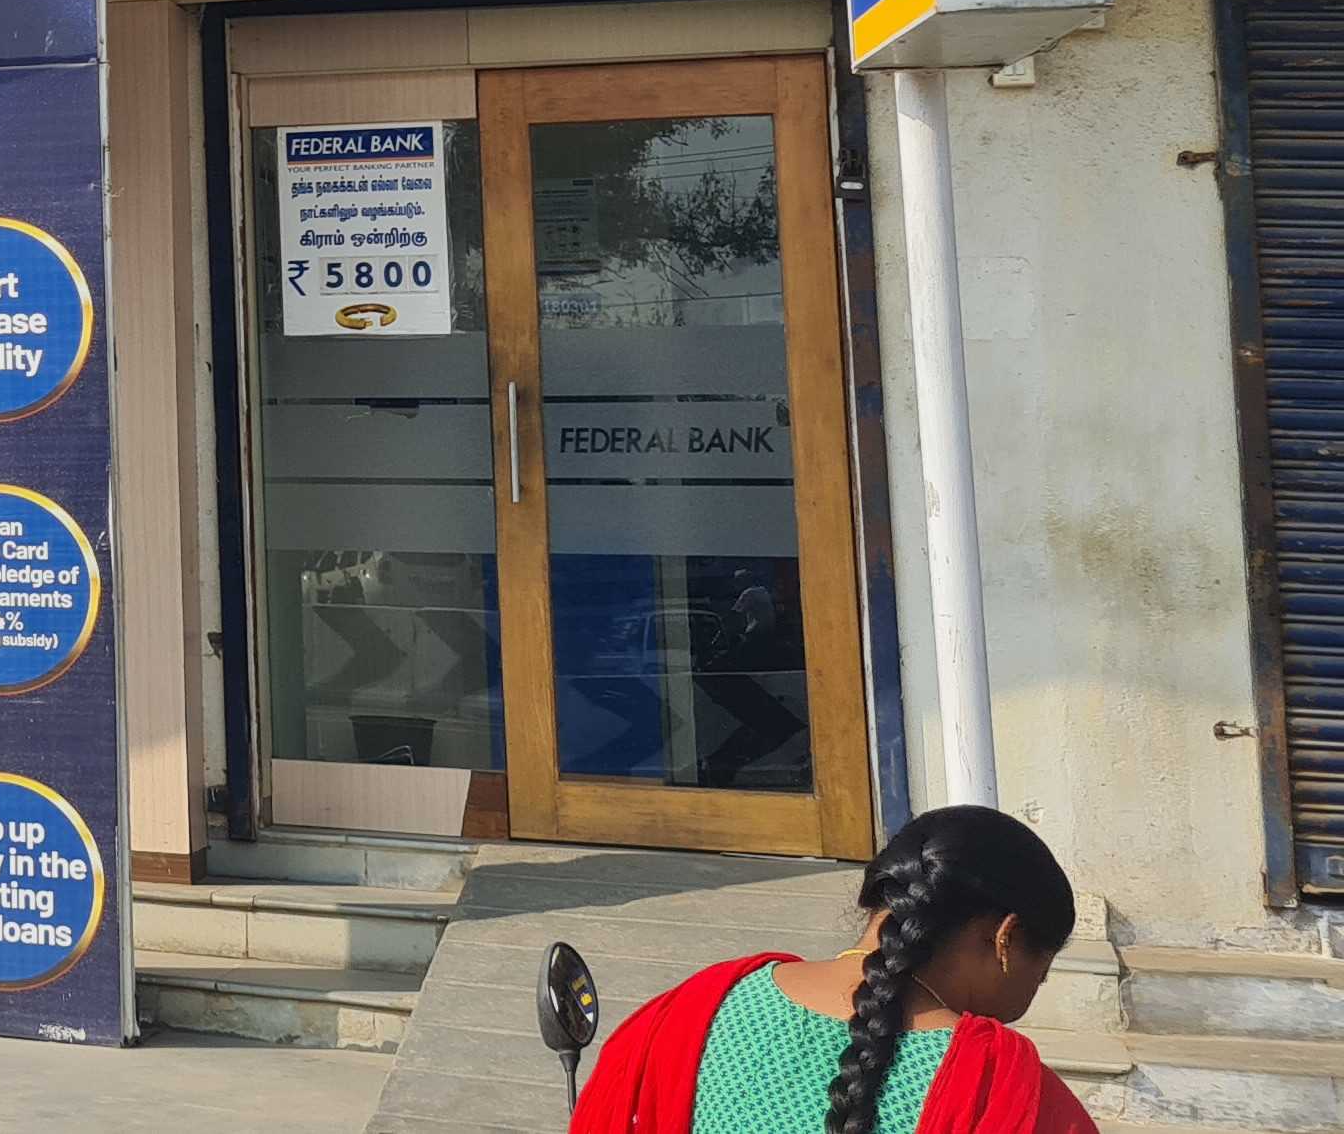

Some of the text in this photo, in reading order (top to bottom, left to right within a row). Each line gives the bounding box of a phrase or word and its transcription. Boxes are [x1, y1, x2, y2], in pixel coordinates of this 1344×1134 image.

[290, 133, 424, 156] FEDERAL BANK
[288, 161, 435, 174] YOUR PERFECT BANKING PARTNER
[291, 177, 314, 198] தங்க
[299, 227, 428, 249] கிராம் ஒன்றிற்கு
[325, 261, 432, 289] 5800
[560, 426, 775, 454] FEDERAL BANK
[2, 541, 49, 560] Card
[58, 566, 80, 585] of
[3, 633, 59, 650] subsidy)
[9, 821, 45, 850] up
[9, 847, 35, 877] in
[39, 851, 88, 880] the
